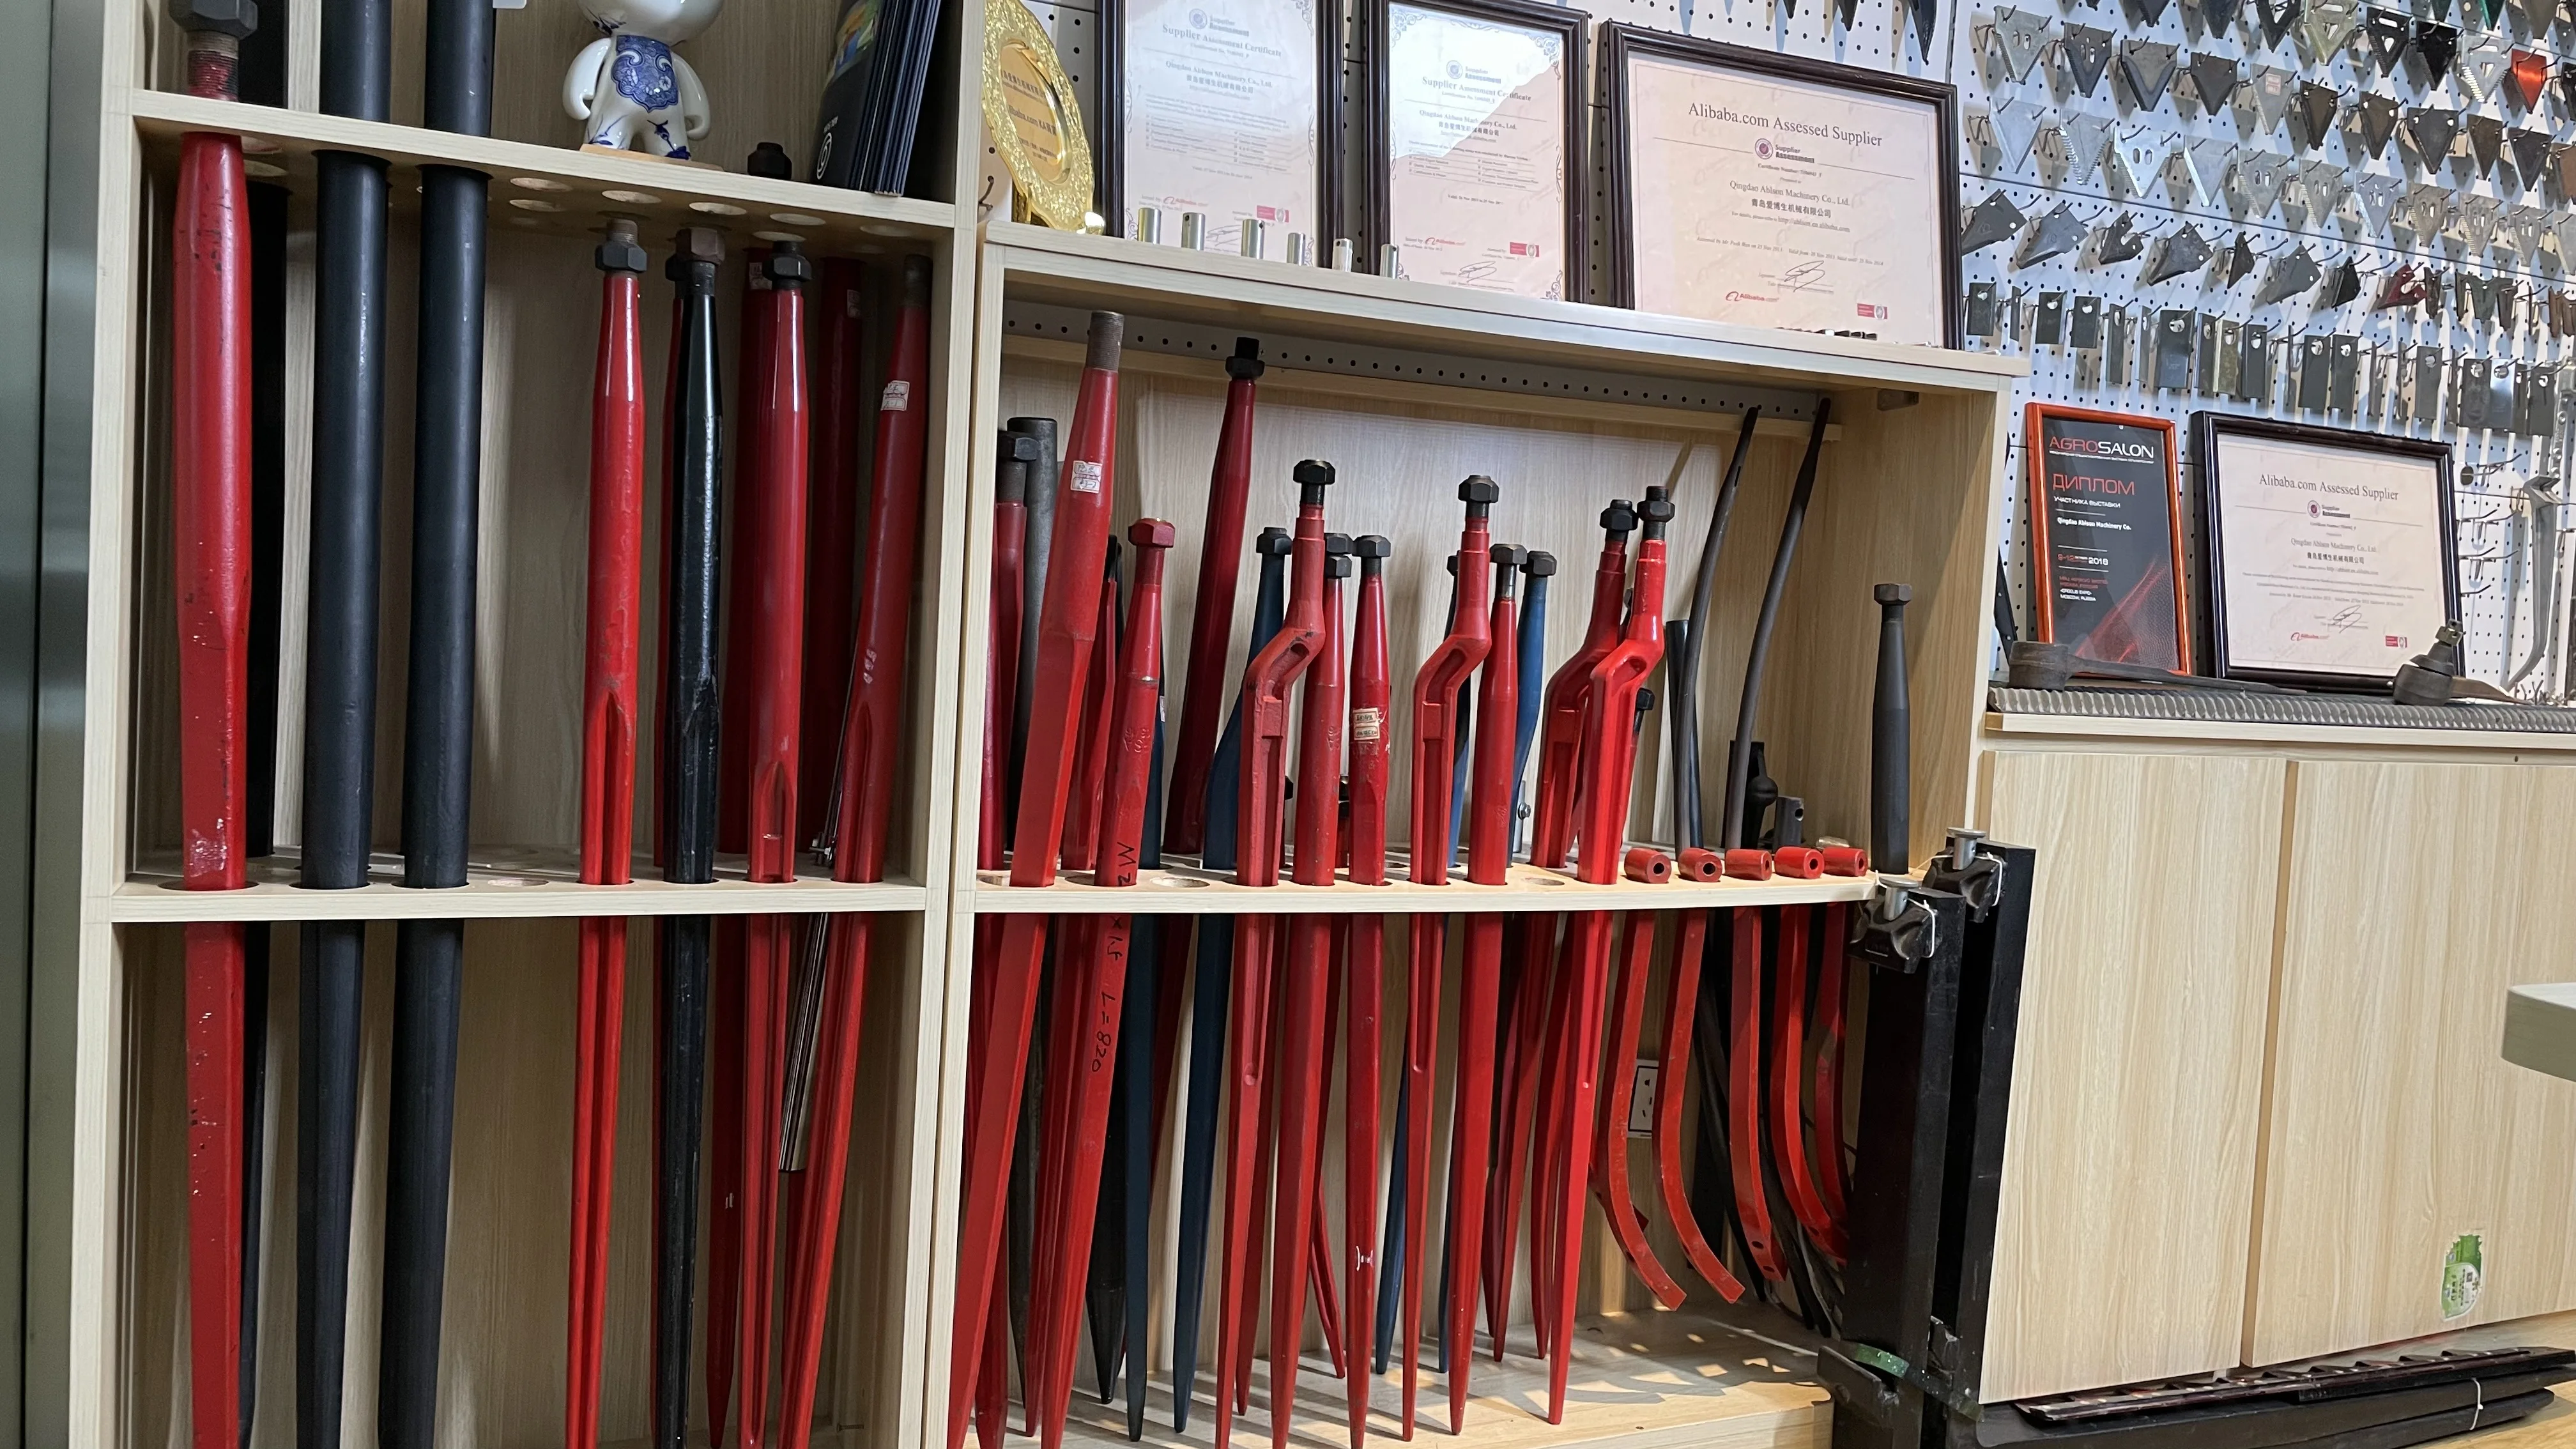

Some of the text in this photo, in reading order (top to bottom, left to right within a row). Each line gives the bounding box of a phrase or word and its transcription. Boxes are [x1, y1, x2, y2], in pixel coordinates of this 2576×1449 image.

[1162, 24, 1201, 41] Supplier
[1202, 35, 1243, 49] Assessment
[1245, 43, 1282, 57] Certificate
[1166, 61, 1192, 72] Qingdao
[1215, 70, 1246, 84] Machinery
[1422, 76, 1457, 90] Supplier
[1459, 84, 1496, 96] Assessment
[1497, 89, 1531, 102] Certificate
[1419, 109, 1443, 119] Qingdao
[1689, 102, 1883, 148] Alibaba.com Assessed Supplier
[1775, 144, 1801, 154] Supplier
[1775, 151, 1815, 164] Assessment
[1729, 180, 1850, 206] Qingdao Ablson Machinery Co., Ltd.
[1751, 197, 1832, 218] 青岛爱博生机械有限公司
[2049, 436, 2154, 459] AGROSALON
[2053, 473, 2135, 496] ДИПЛОМ
[2259, 473, 2399, 502] Alibaba.com Assessed Supplier
[2054, 496, 2121, 509] УЧАСТНИКА ВЫСТАВКИ
[2057, 517, 2077, 525] Qingdao
[2096, 521, 2122, 531] Machinery
[2290, 538, 2312, 549] Qingdao
[2331, 542, 2356, 552] Machinery
